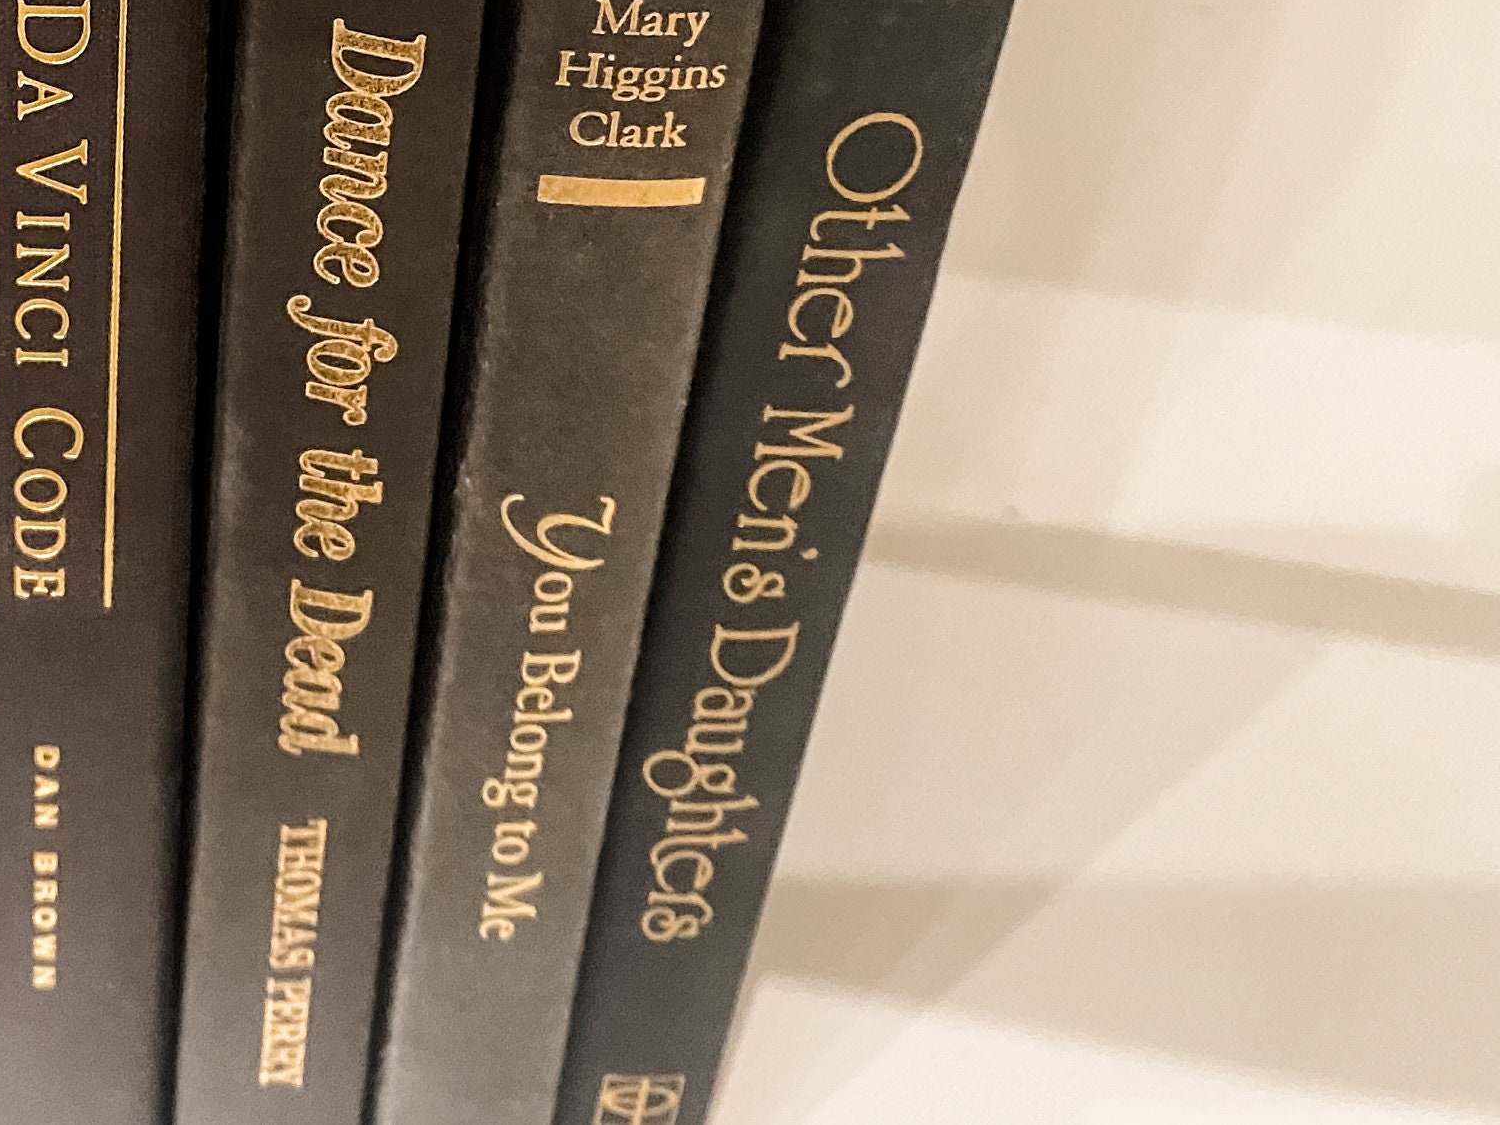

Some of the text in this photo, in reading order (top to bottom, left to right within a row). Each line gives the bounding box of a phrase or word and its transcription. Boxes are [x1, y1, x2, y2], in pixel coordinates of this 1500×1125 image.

[554, 50, 729, 103] Higgins
[568, 111, 688, 149] Clark
[15, 139, 89, 368] VINCI
[13, 406, 85, 601] CODE
[278, 17, 428, 756] Dance for the Dead
[640, 111, 925, 943] Other Men's Daughters
[479, 493, 617, 942] You Belong to Me
[31, 744, 61, 991] DAN BROWN
[258, 818, 328, 1088] THOMAS PERRY
